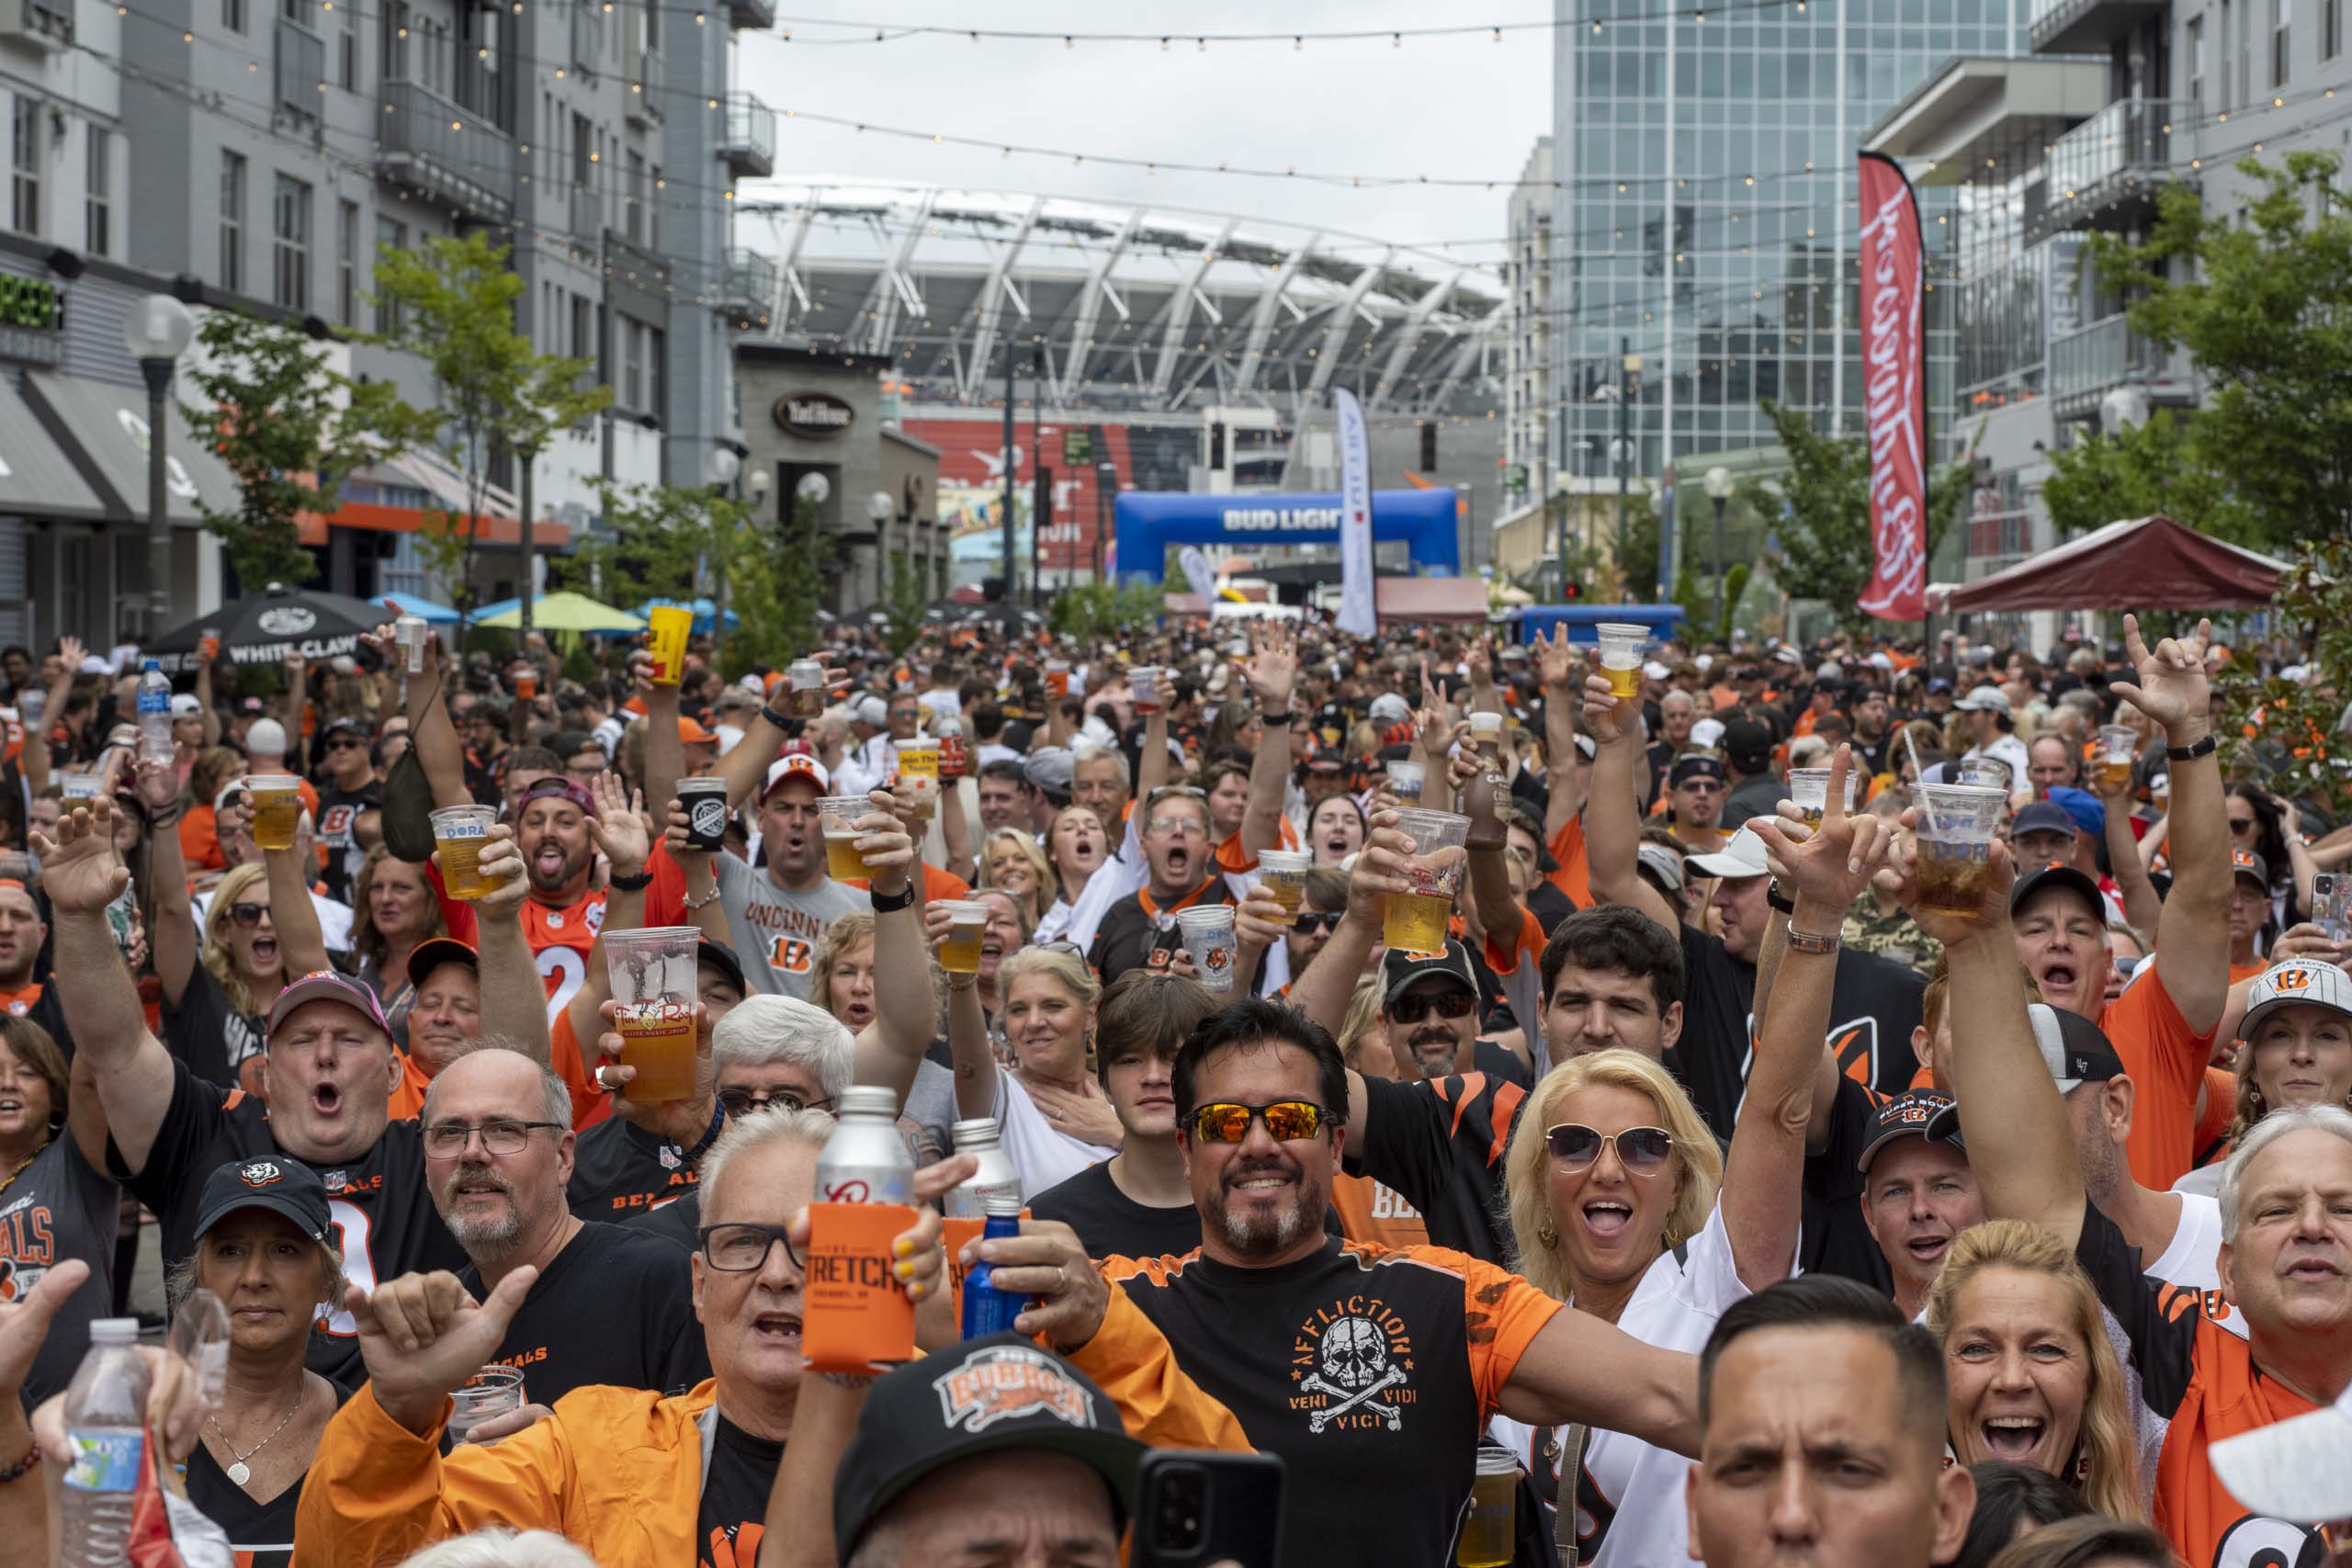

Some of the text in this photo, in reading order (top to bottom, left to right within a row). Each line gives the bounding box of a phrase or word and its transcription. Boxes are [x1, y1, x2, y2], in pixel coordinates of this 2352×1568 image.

[1224, 508, 1278, 531] BUD
[232, 635, 357, 663] WHITE CLAW
[901, 754, 935, 765] Join The
[447, 826, 485, 839] DORA
[1934, 840, 1990, 861] DOR
[615, 1002, 693, 1026] Tin Roof
[1879, 1099, 1949, 1120] SUPER BOW
[1292, 1294, 1412, 1366] AFFLICTION
[1289, 1394, 1329, 1410] VENI
[1384, 1389, 1418, 1404] VIDI
[1337, 1414, 1381, 1430] VICI
